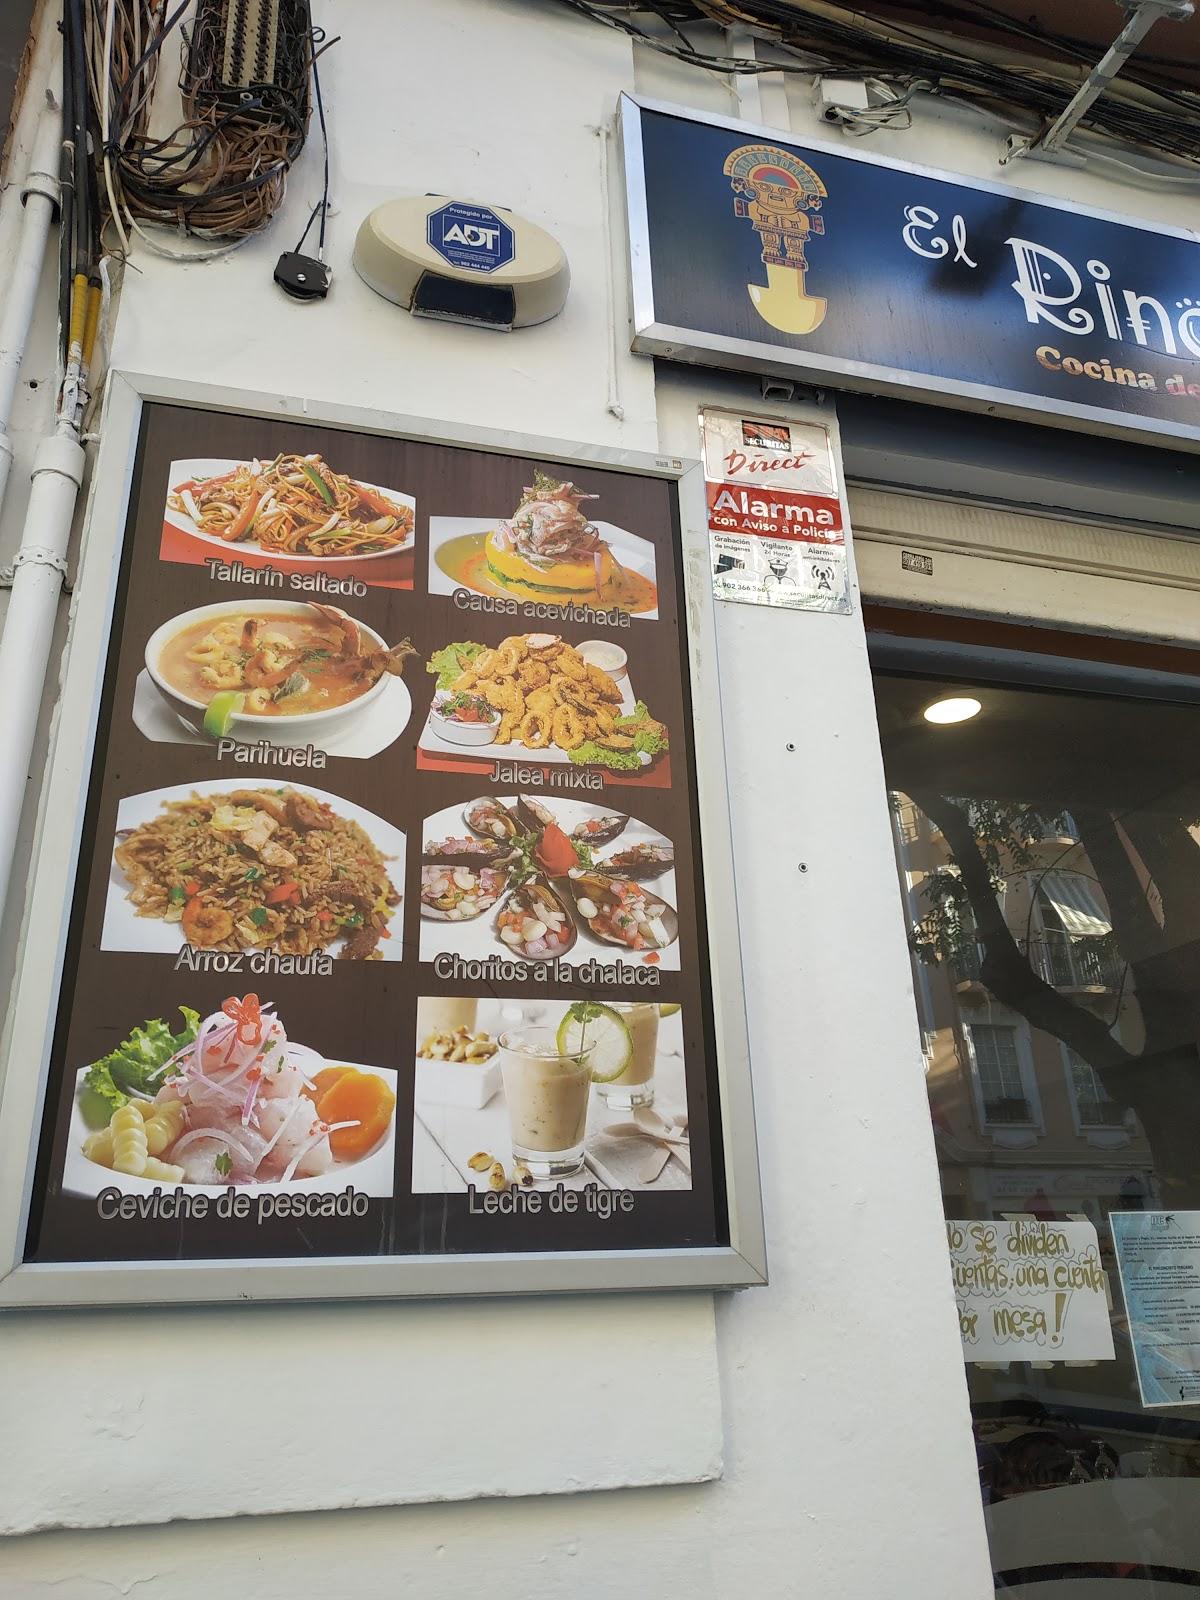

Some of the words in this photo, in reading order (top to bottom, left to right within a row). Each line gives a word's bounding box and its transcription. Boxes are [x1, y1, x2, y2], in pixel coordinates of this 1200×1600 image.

[449, 207, 480, 218] Protegido
[444, 223, 499, 250] ADT
[902, 205, 977, 268] El
[1036, 345, 1158, 393] Cocina
[723, 448, 817, 475] Direct
[713, 489, 834, 526] Alarma
[713, 516, 738, 527] con
[742, 519, 778, 532] Aviso
[782, 526, 790, 534] a
[714, 535, 751, 546] Grabación
[205, 558, 284, 588] Tallarín
[289, 571, 368, 597] saltado
[722, 582, 736, 590] 902
[452, 588, 518, 615] Causa
[523, 599, 631, 628] acevichada
[217, 737, 327, 769] Parihuela
[489, 761, 544, 786] Jalea
[550, 767, 604, 790] mixta
[173, 944, 246, 973] Arroz
[250, 947, 334, 976] chaufa
[433, 952, 528, 981] Choritos
[533, 961, 548, 982] a
[554, 957, 573, 983] la
[578, 958, 661, 986] chalaca
[96, 1186, 209, 1220] Ceviche
[216, 1186, 250, 1218] de
[258, 1185, 369, 1225] pescado
[468, 1184, 542, 1214] Leche
[549, 1183, 579, 1213] de
[584, 1183, 635, 1220] tigre
[1007, 1221, 1069, 1256] dividen
[1016, 1265, 1048, 1288] una
